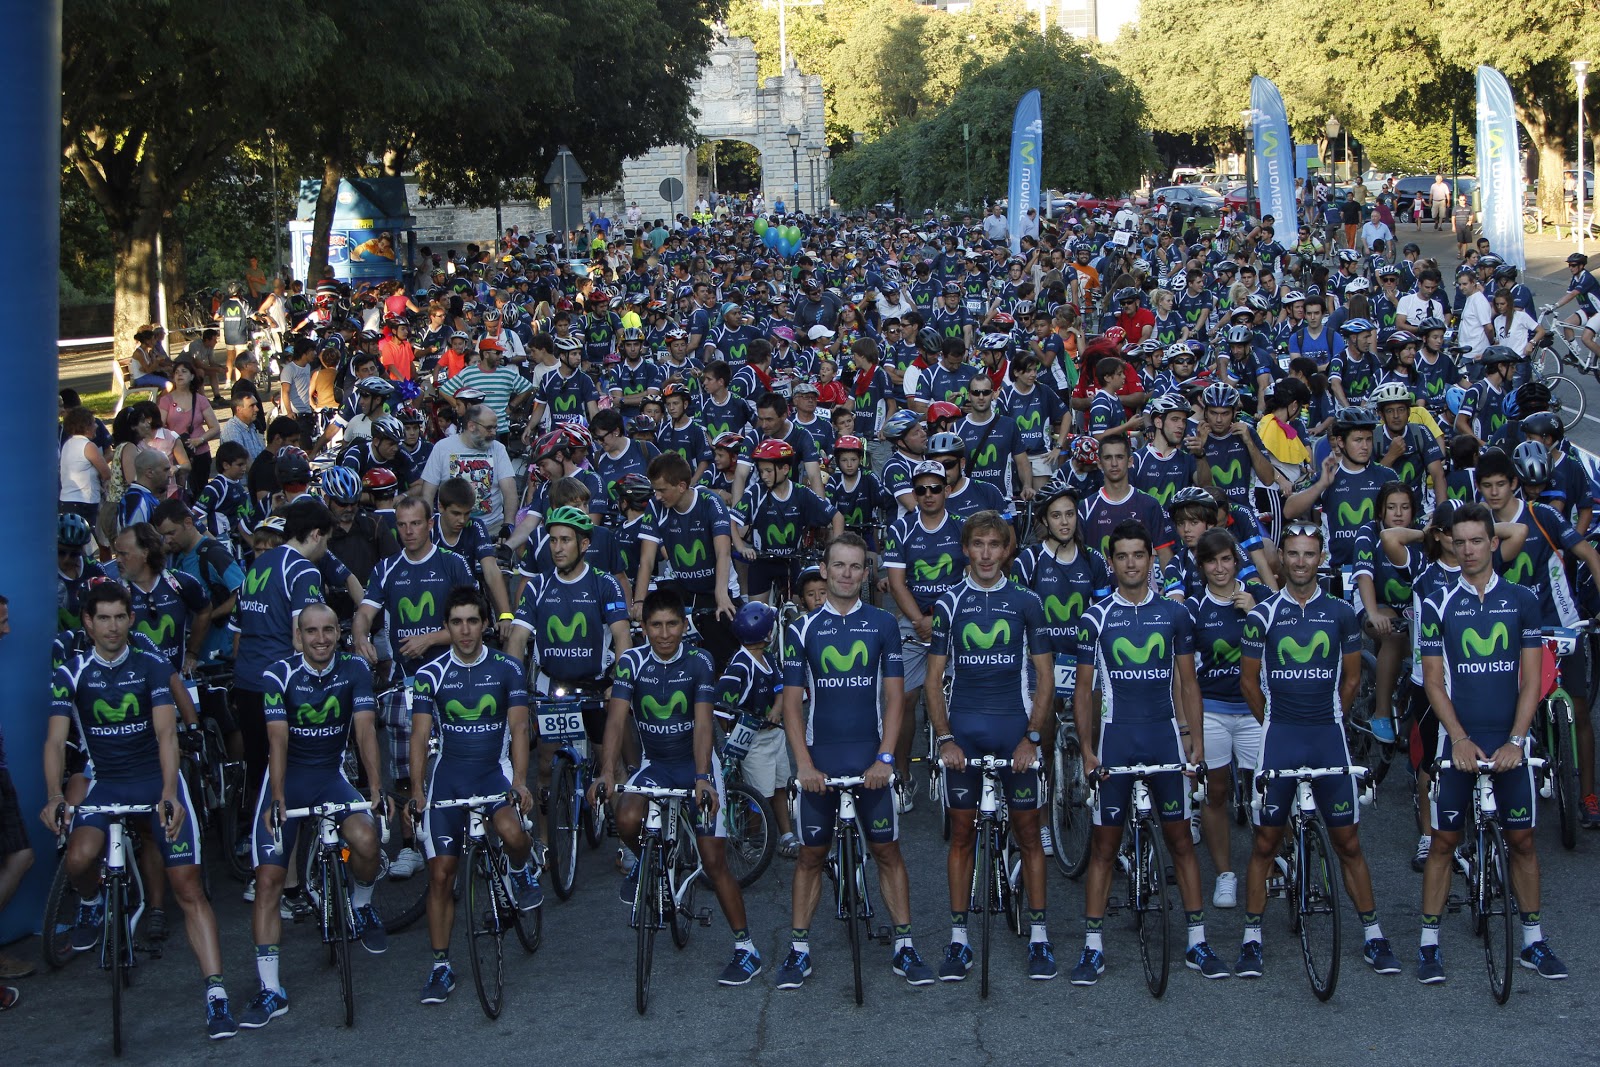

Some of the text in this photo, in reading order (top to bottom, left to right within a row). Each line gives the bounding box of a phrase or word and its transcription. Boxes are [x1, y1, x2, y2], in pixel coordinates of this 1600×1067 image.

[971, 469, 1001, 478] movistar
[1238, 506, 1257, 528] movistar
[1540, 503, 1565, 523] movistar
[452, 551, 473, 577] movistar
[674, 568, 715, 579] movistar
[604, 574, 622, 598] movistar
[1554, 582, 1570, 615] movistar
[397, 625, 442, 638] movistar
[544, 647, 593, 658] movistar
[959, 653, 1016, 665] movistar
[504, 658, 522, 676] movistar
[697, 652, 713, 671] movistar
[1457, 660, 1515, 674] movistar
[1110, 669, 1170, 680] movistar
[1271, 668, 1334, 679] movistar
[817, 675, 873, 688] movistar
[90, 720, 148, 736] movistar
[442, 722, 503, 733] movistar
[545, 715, 580, 731] 896
[290, 724, 345, 737] movistar
